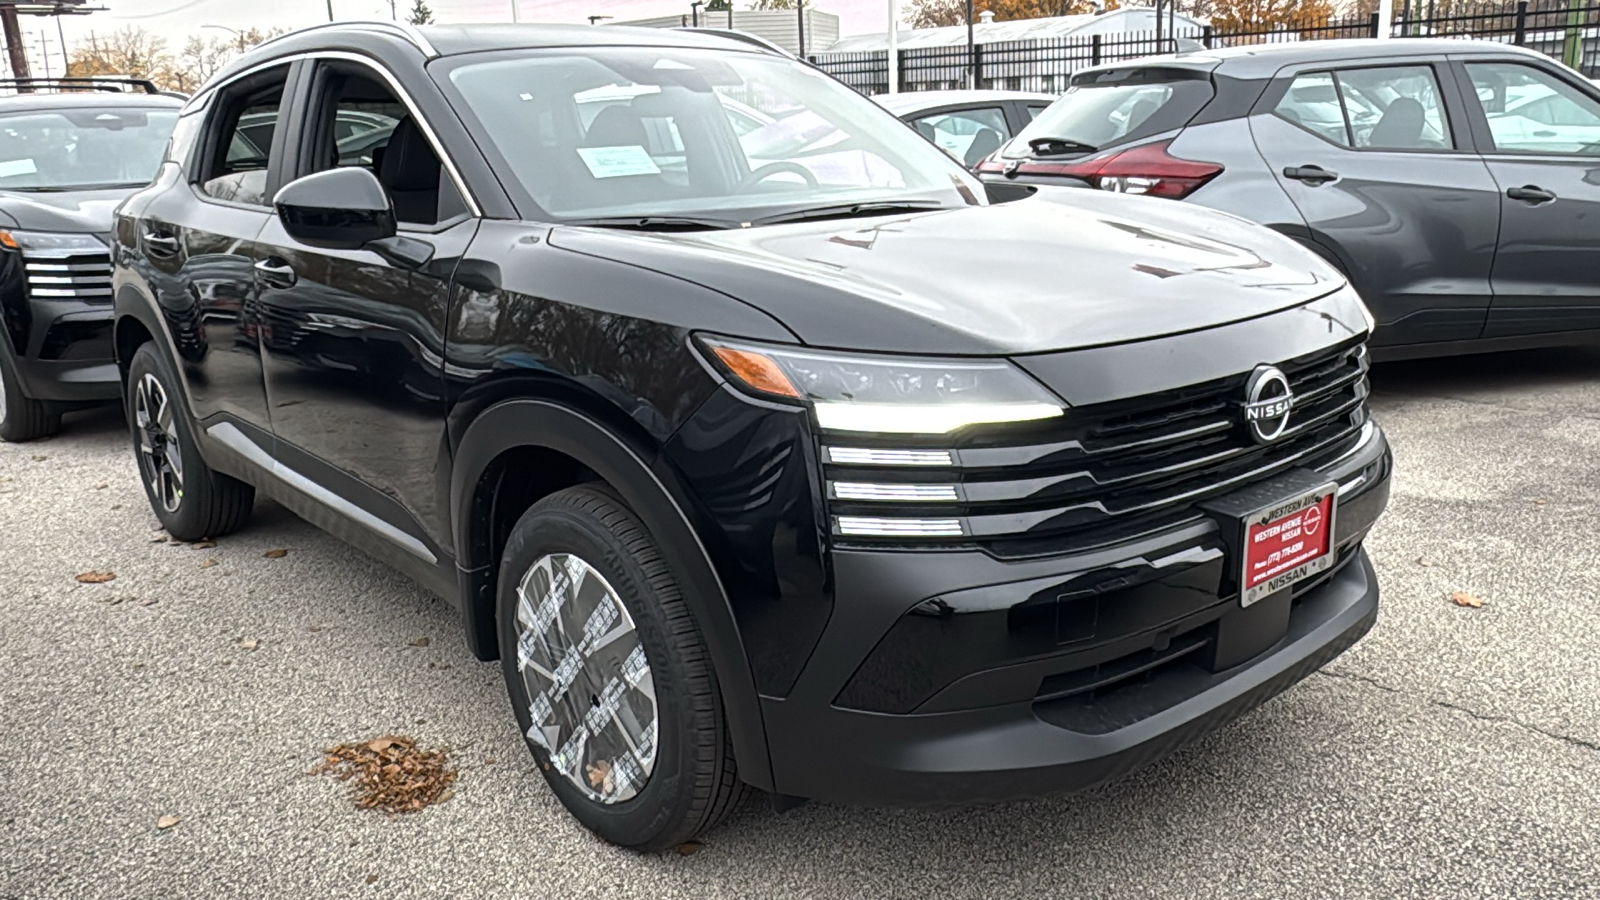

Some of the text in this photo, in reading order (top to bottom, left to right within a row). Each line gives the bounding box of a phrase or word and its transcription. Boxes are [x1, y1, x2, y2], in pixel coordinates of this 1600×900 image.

[1247, 398, 1293, 420] NISSAN
[1268, 493, 1317, 520] WESTERN AVE
[1254, 516, 1302, 543] WESTERN AVENUE
[1281, 527, 1302, 542] NISSAN
[1268, 565, 1308, 592] NISSAN
